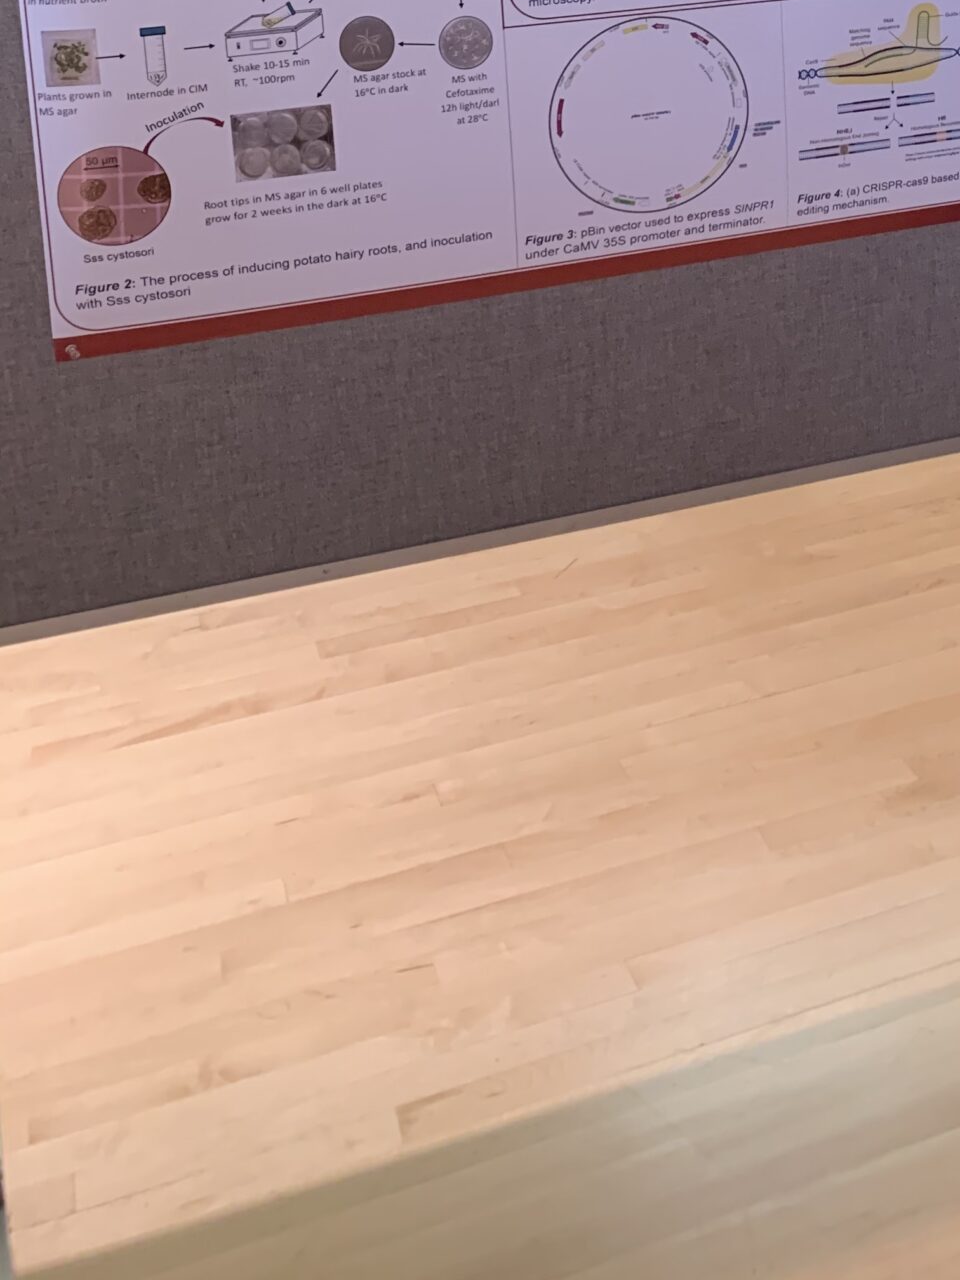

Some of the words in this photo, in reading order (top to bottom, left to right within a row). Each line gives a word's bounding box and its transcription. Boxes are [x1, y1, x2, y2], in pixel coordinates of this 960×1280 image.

[232, 62, 261, 73] Shake
[263, 58, 290, 70] 10-15
[292, 57, 310, 66] min
[126, 87, 174, 100] Internode
[177, 87, 186, 95] in
[188, 83, 208, 94] CIM
[145, 102, 205, 133] Inoculation
[797, 191, 831, 204] Figure
[833, 188, 843, 198] 4:
[846, 186, 860, 198] (a)
[862, 175, 929, 194] CRISPR-cas9
[930, 171, 959, 184] based
[524, 233, 564, 246] Figure
[566, 229, 577, 239] 3:
[580, 226, 605, 239] pBin
[608, 220, 641, 233] vector
[644, 215, 671, 227] used
[673, 214, 684, 223] to
[686, 207, 730, 221] express
[74, 282, 120, 296] Figure
[123, 278, 135, 289] 2:
[139, 275, 165, 287] The
[169, 269, 219, 286] process
[222, 264, 234, 276] of
[238, 260, 290, 274] inducing
[293, 253, 332, 269] potato
[334, 249, 364, 261] hairy
[368, 244, 401, 256] roots,
[404, 238, 427, 251] and
[430, 231, 493, 247] inoculation
[83, 254, 104, 263] Sss
[106, 248, 154, 262] cystosori
